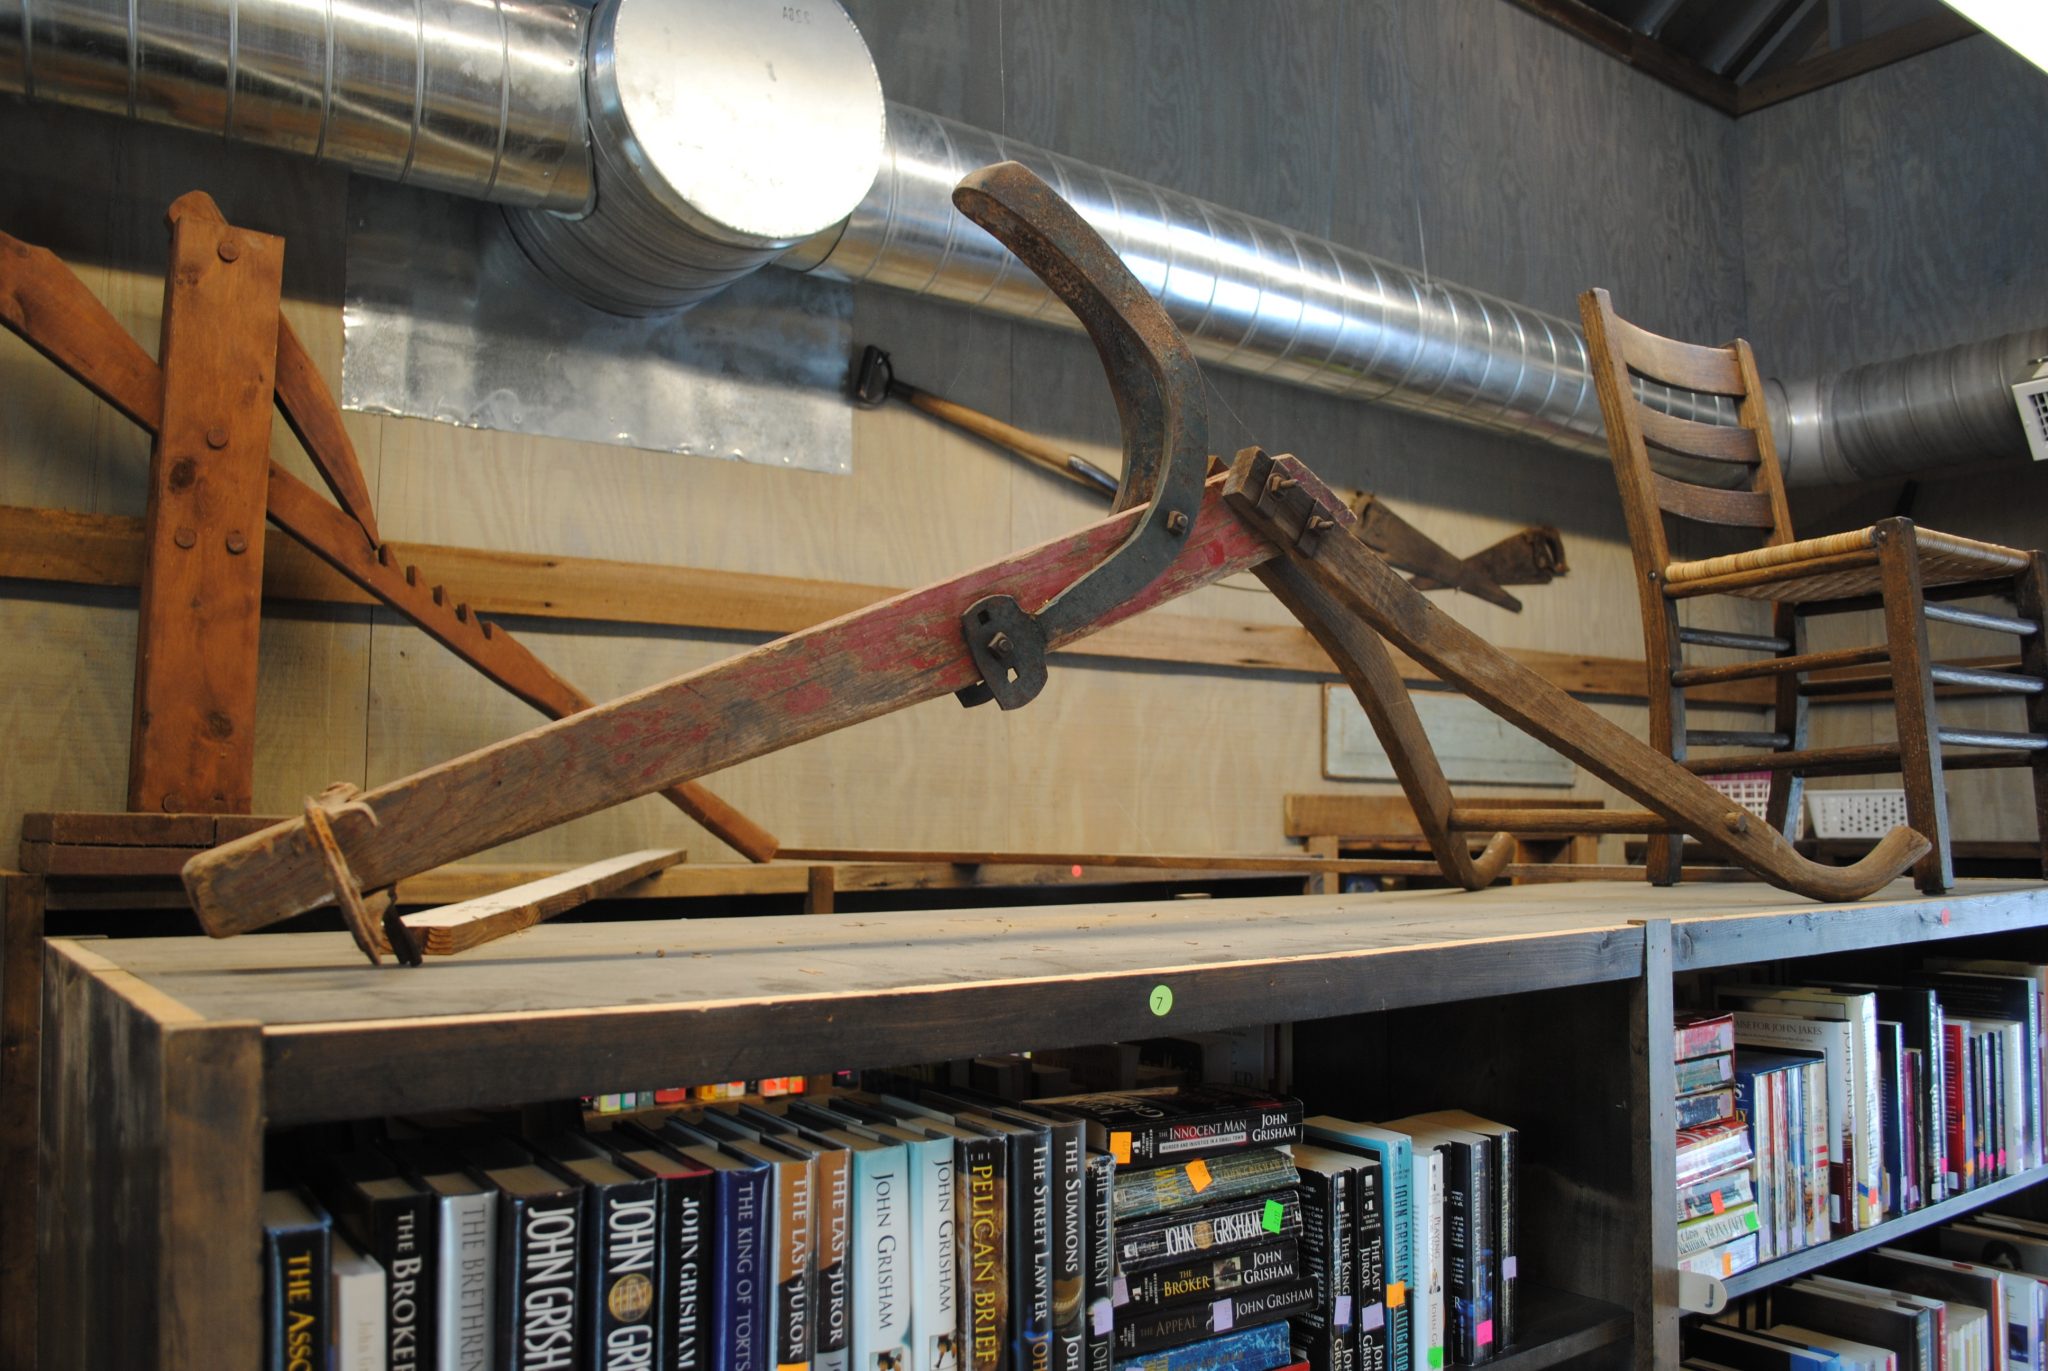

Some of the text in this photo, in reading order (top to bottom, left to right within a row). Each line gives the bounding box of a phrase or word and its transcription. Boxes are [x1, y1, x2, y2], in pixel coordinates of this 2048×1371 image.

[1753, 1021, 1770, 1031] FOR
[1772, 1022, 1796, 1033] JOHN
[1798, 1025, 1823, 1035] JAKES
[1169, 1123, 1223, 1140] INNOCENT
[1223, 1119, 1247, 1132] MAN
[1252, 1126, 1296, 1142] GRISHAM
[1261, 1113, 1288, 1128] JOHN
[1179, 1141, 1189, 1149] AND
[791, 1176, 808, 1277] THE LAST
[831, 1164, 848, 1263] THE LAST
[1064, 1137, 1082, 1272] THE SUMMONS
[398, 1210, 414, 1253] THE
[608, 1198, 656, 1274] JOHN
[870, 1173, 896, 1330] JOHN GRISHAM
[933, 1160, 954, 1313] JOHN GRISHAM
[1032, 1141, 1050, 1322] THE STREET LAWYER
[1094, 1201, 1109, 1287] TESTAMENT
[1165, 1223, 1196, 1257] JOHN
[1213, 1210, 1264, 1246] GRISHAM
[1342, 1234, 1352, 1259] THE
[1394, 1184, 1409, 1283] JOHN GRISHAM
[1433, 1215, 1442, 1260] PLAYING
[288, 1250, 311, 1304] THE
[735, 1181, 755, 1371] THE KING OF TORTS
[972, 1165, 997, 1363] PELICAN BRIEF
[1179, 1270, 1192, 1279] THE
[1243, 1264, 1294, 1285] GRISHAM
[1253, 1250, 1282, 1266] JOHN
[1333, 1237, 1342, 1297] OF TORTS
[1342, 1260, 1352, 1295] KING
[1359, 1246, 1372, 1290] JUROR
[1371, 1235, 1382, 1293] THE LAST
[459, 1204, 486, 1371] THE BRETHREN
[523, 1207, 576, 1371] JOHN GRISH
[677, 1197, 700, 1369] JOHN GRISHAM
[828, 1266, 845, 1344] JUROR
[1164, 1275, 1210, 1298] BROKER
[1235, 1288, 1314, 1320] JOHN GRISHAM
[1704, 1283, 1714, 1308] J
[787, 1281, 805, 1359] JUROR
[1140, 1327, 1153, 1337] THE
[1155, 1315, 1198, 1337] APPEAL
[1028, 1332, 1049, 1371] JOH
[1061, 1335, 1082, 1371] JOH
[1089, 1341, 1109, 1371] JOH
[1372, 1344, 1384, 1371] JOH
